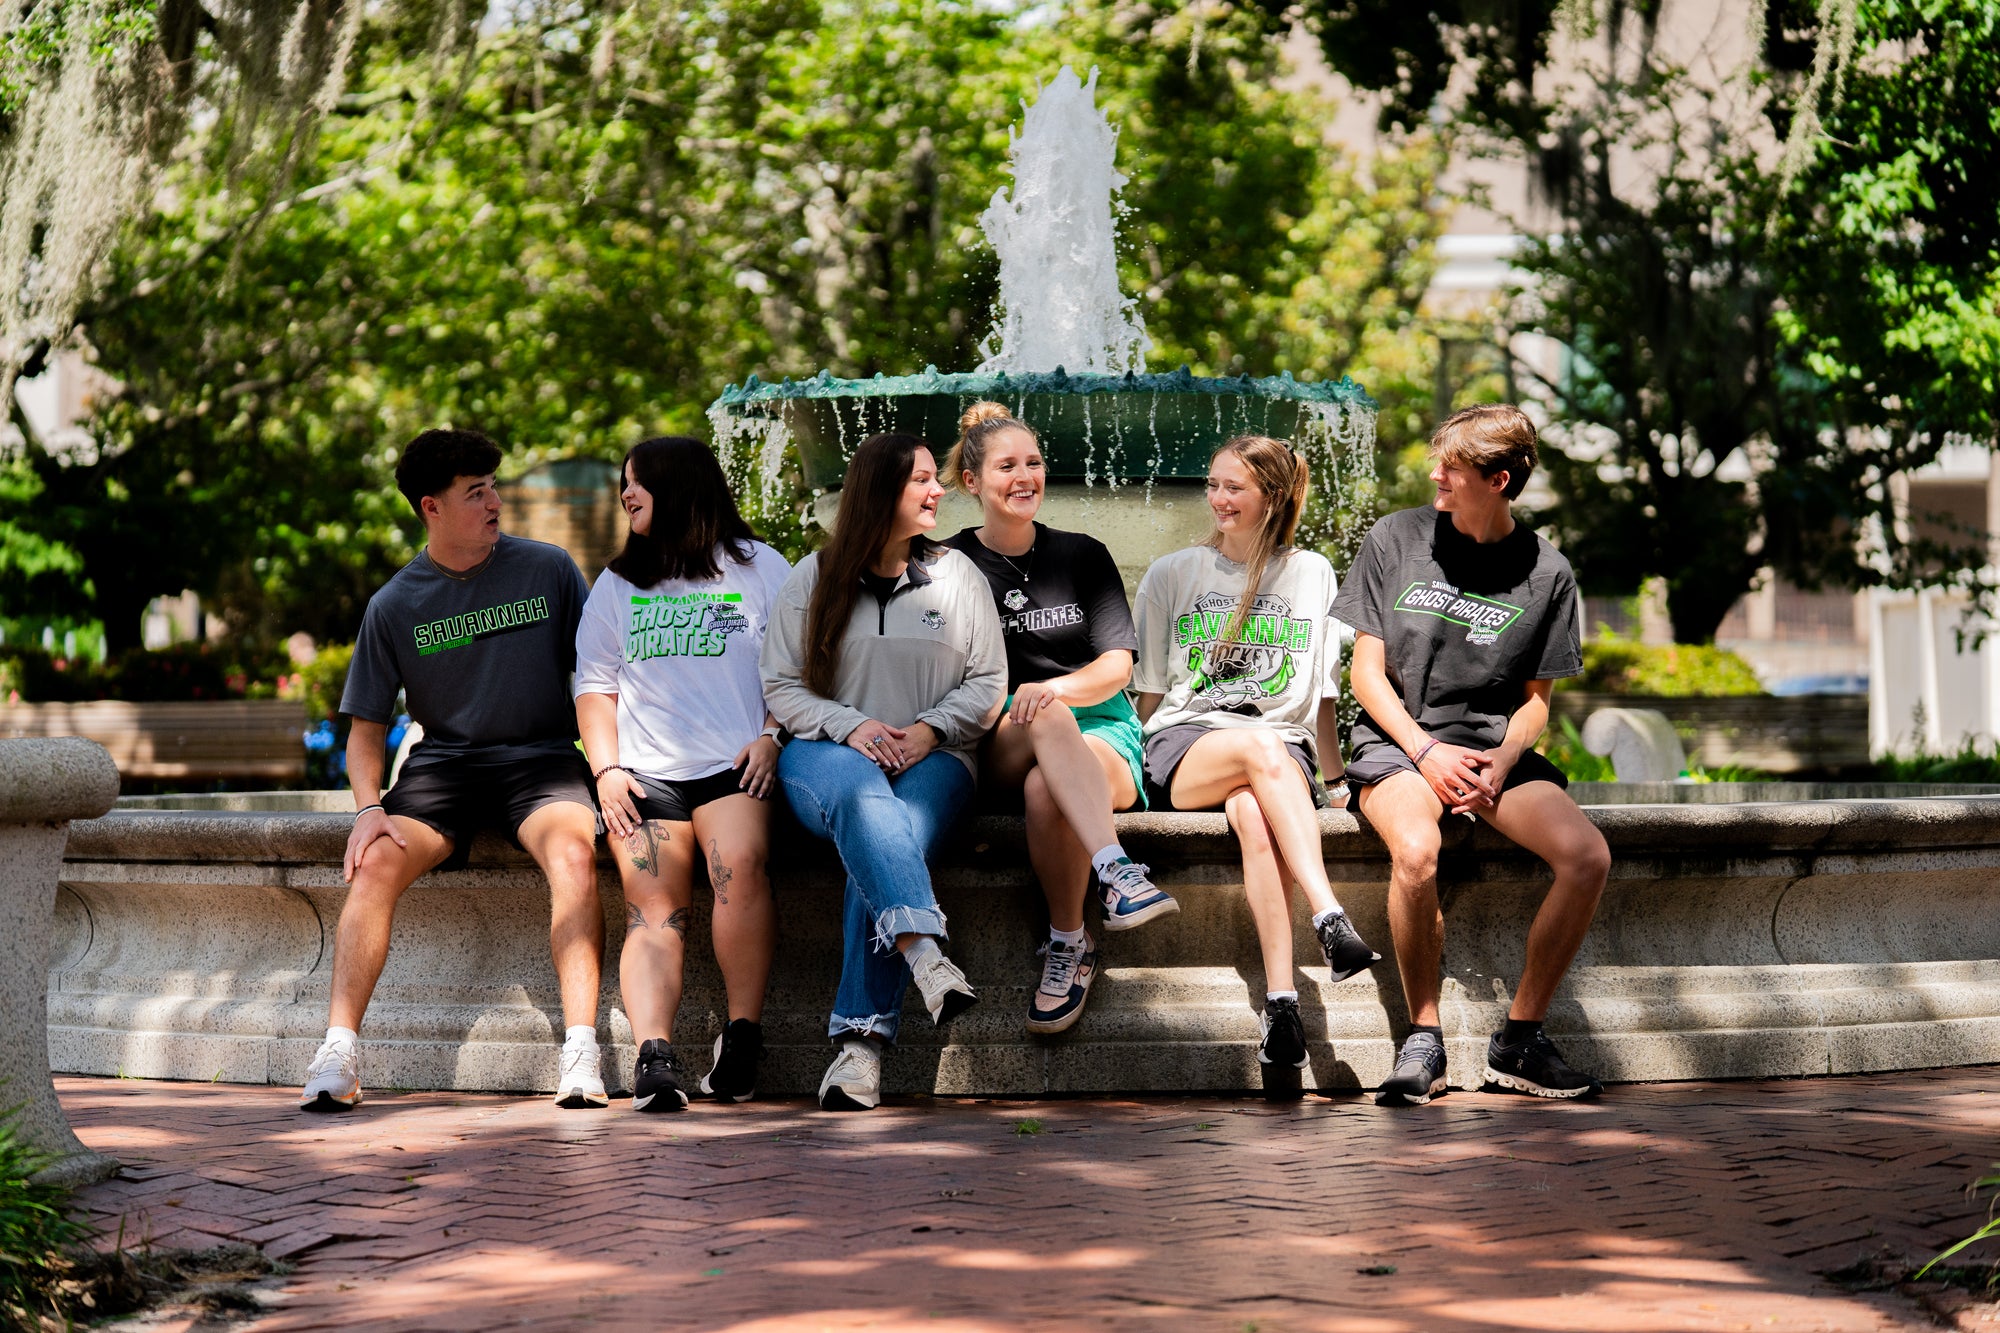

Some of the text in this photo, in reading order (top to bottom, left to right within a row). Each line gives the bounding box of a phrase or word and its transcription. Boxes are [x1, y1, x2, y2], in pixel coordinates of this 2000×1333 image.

[648, 593, 725, 606] SAVANNAH
[1201, 597, 1236, 609] GHOST
[1404, 588, 1511, 627] GHOST PIRATES
[413, 596, 550, 649] SAVANNAH
[630, 602, 708, 635] GHOST
[1016, 603, 1084, 633] PIRATES
[1176, 610, 1312, 653] SAVANNAH
[625, 628, 727, 664] PIRATES
